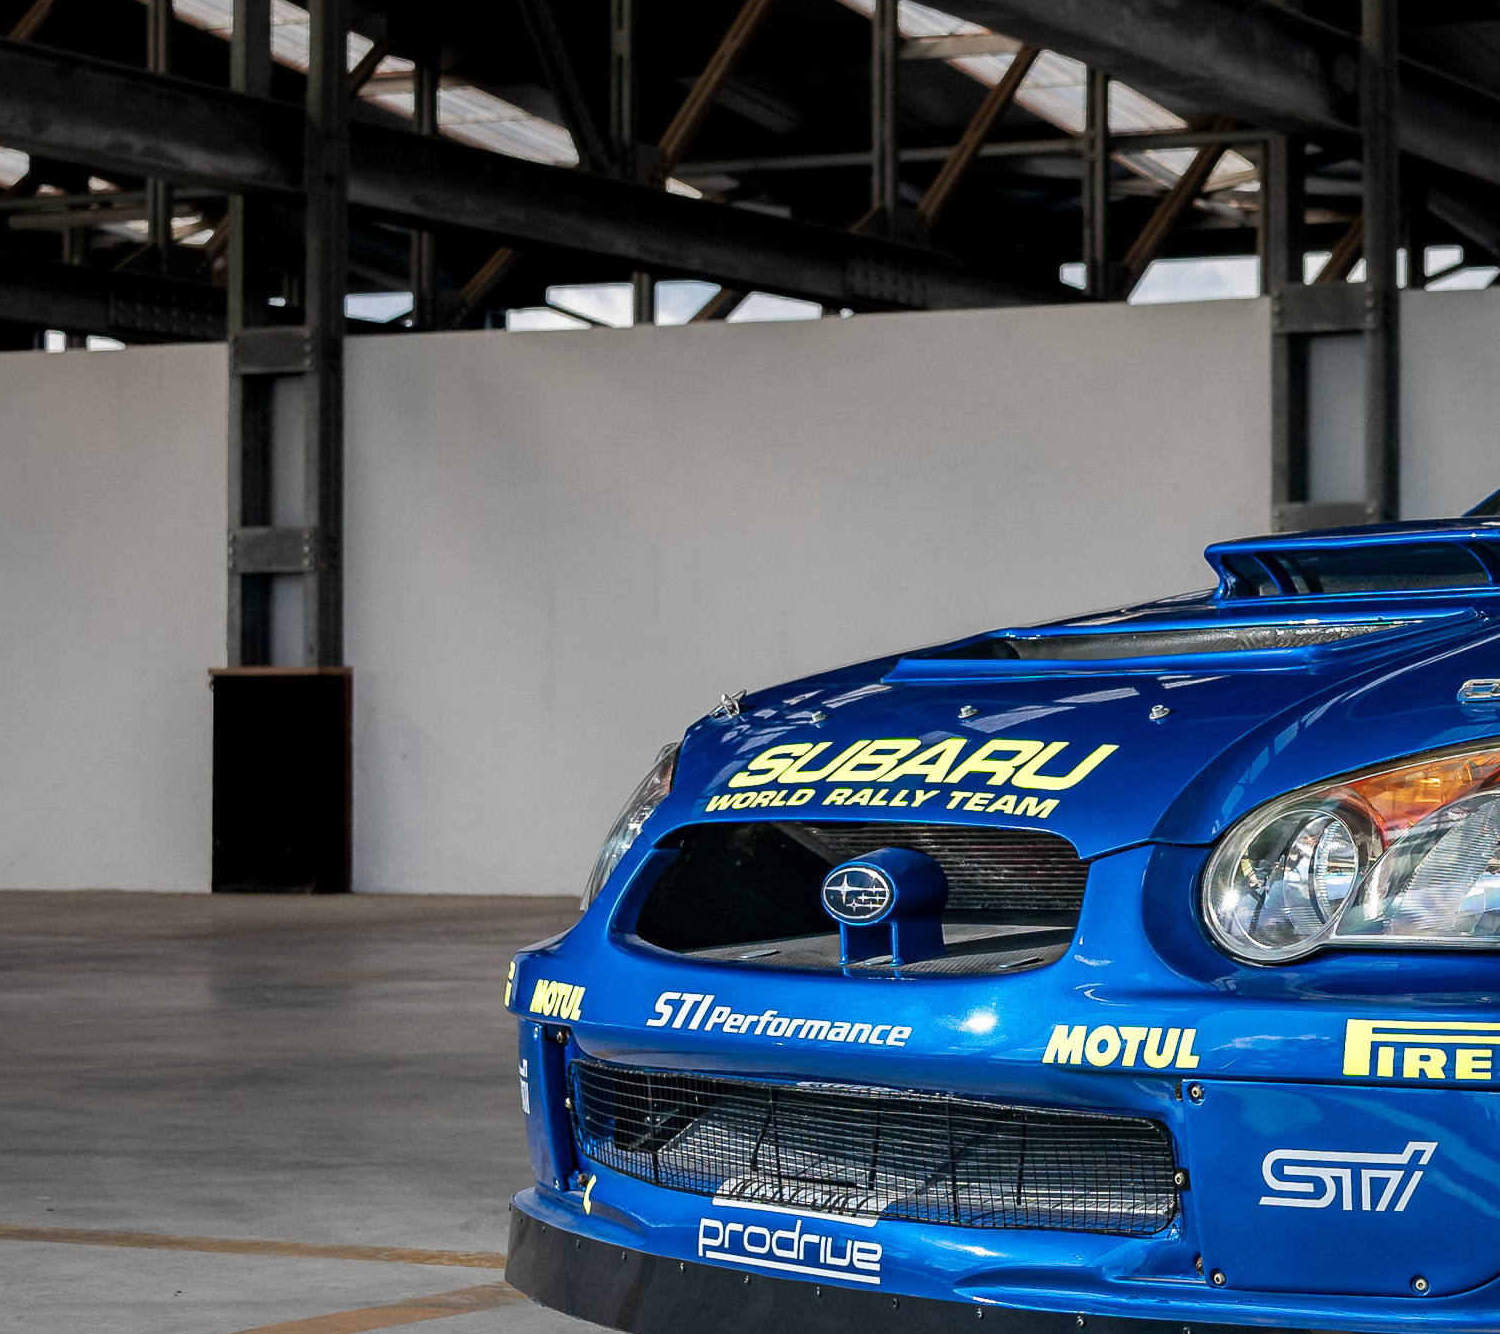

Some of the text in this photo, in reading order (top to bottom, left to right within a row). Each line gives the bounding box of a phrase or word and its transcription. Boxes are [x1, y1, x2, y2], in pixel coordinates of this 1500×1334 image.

[728, 737, 1119, 791] SUBARU
[705, 786, 1060, 819] WORLD RALLY TEAM
[529, 979, 586, 1021] MOTUL
[646, 991, 913, 1047] STI Performance
[1042, 1025, 1200, 1069] MOTUL
[698, 1218, 883, 1272] prodrive
